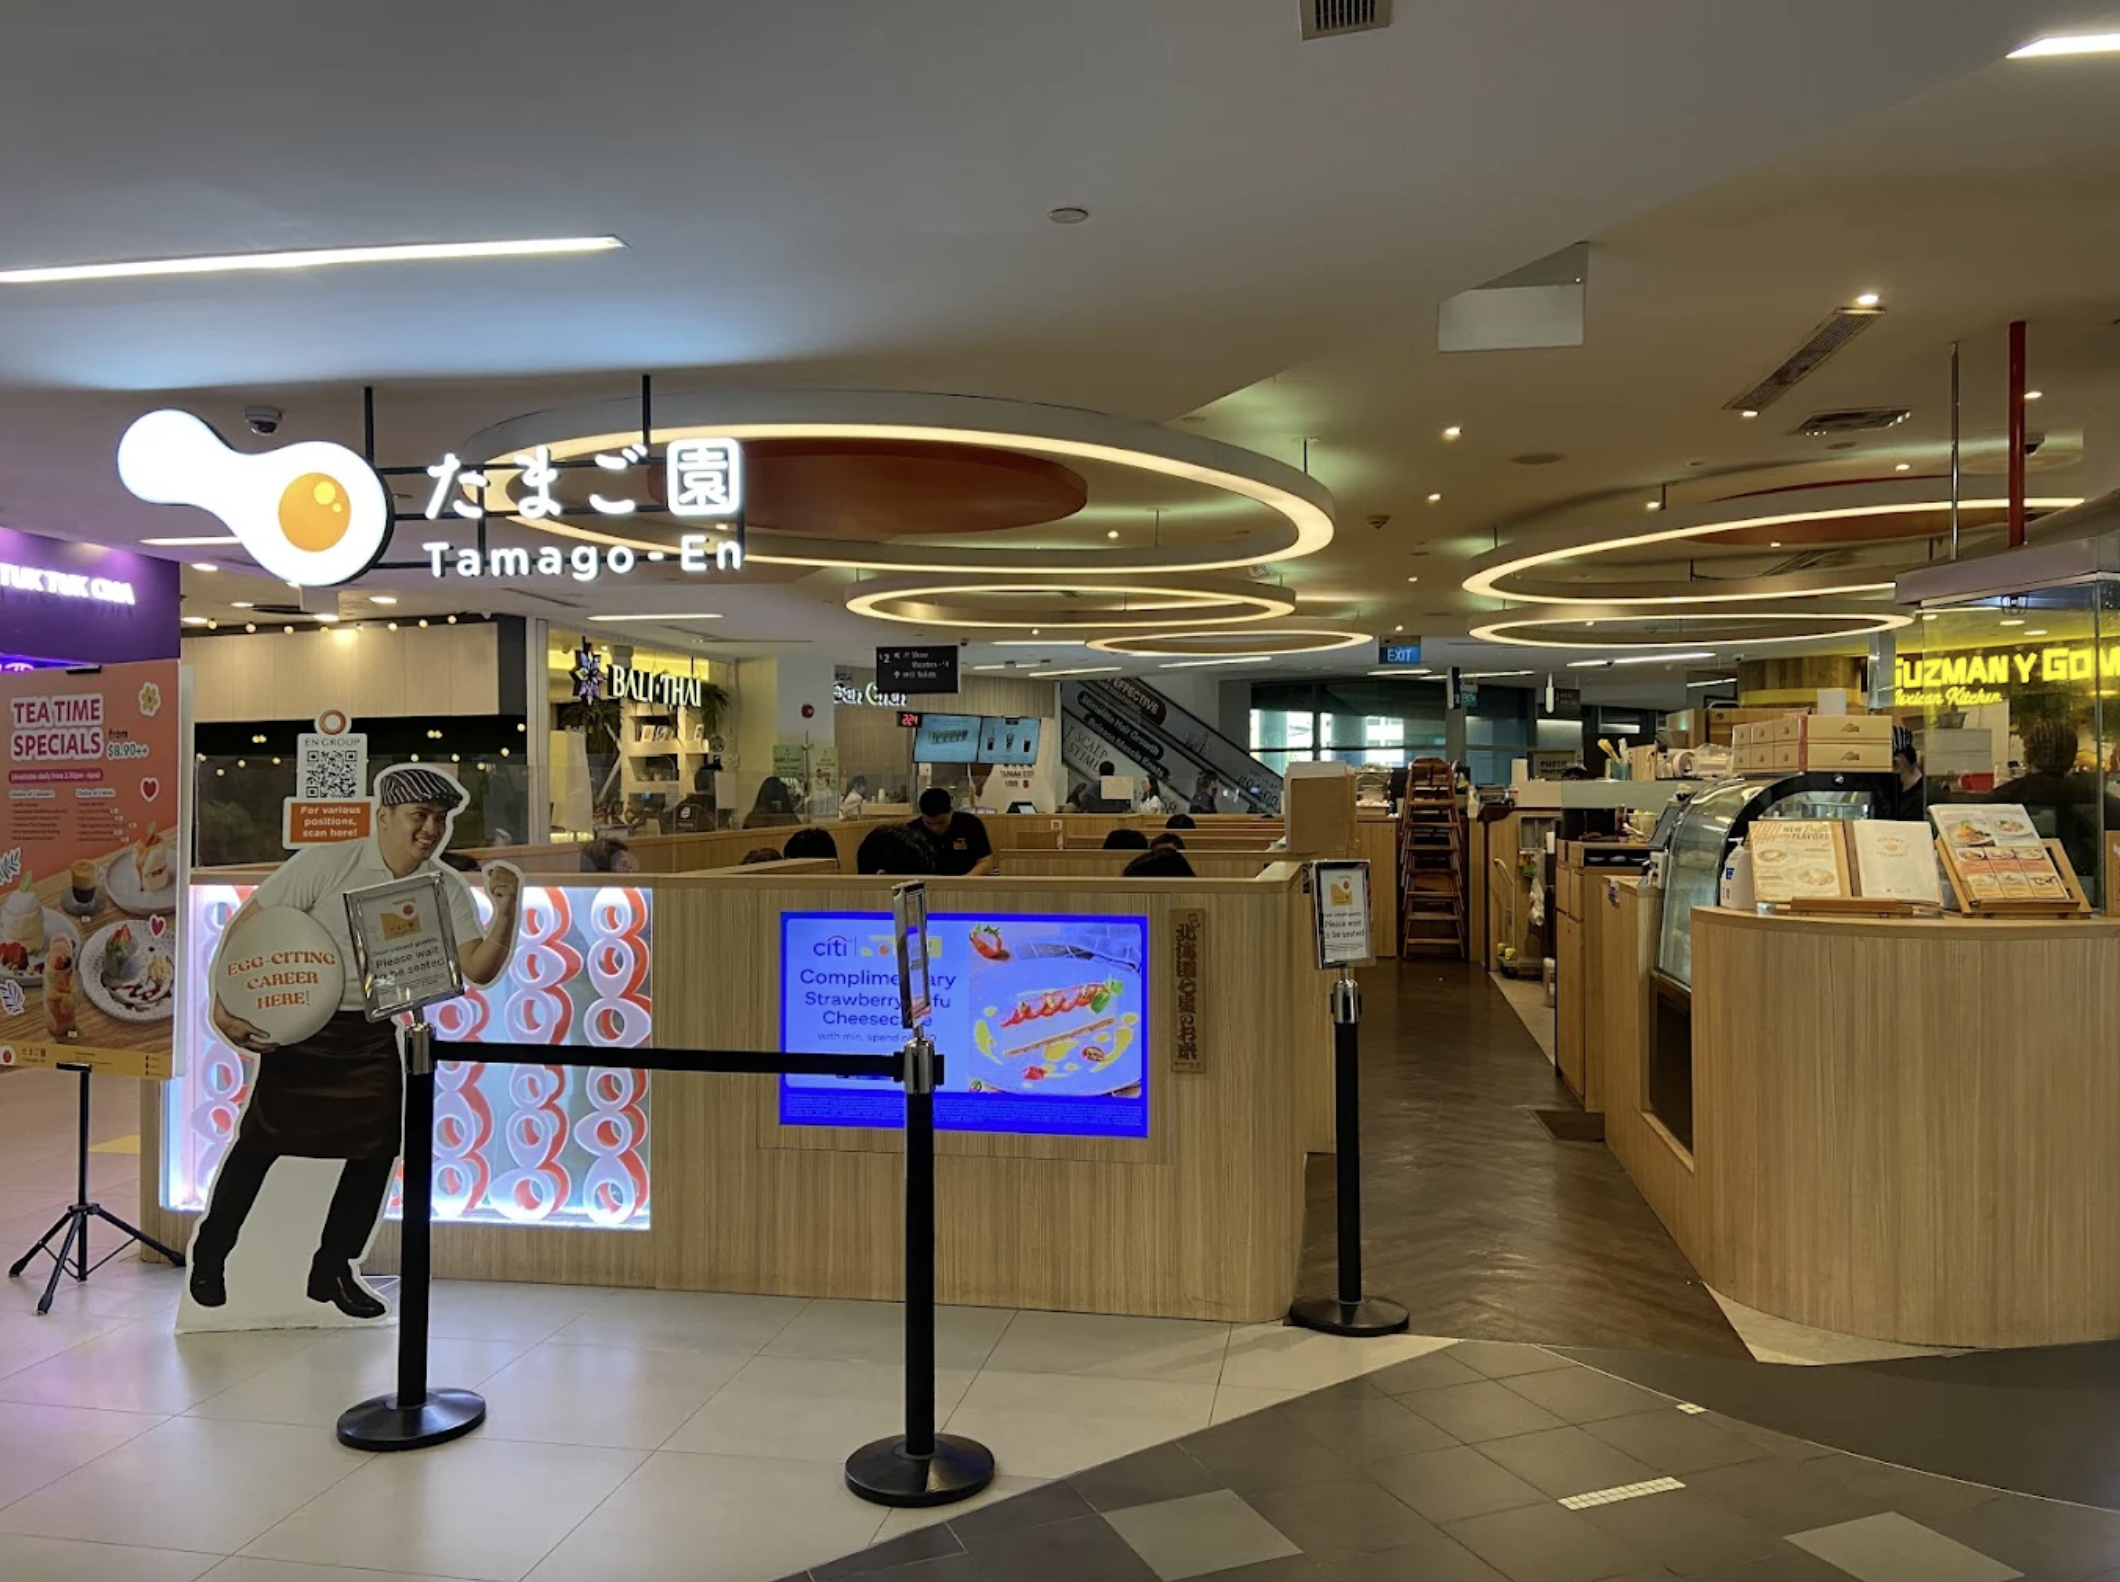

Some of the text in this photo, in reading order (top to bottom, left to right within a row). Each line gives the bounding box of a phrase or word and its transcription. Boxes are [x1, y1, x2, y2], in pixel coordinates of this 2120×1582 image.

[425, 437, 743, 519] たまご園
[1387, 648, 1412, 662] EXIT
[2014, 652, 2037, 683] Y
[14, 699, 101, 724] TEA TIME
[14, 732, 101, 757] SPECIALS
[108, 729, 128, 739] from
[305, 738, 360, 747] EN GROUP
[301, 806, 361, 814] For various
[302, 829, 327, 838] scan
[813, 936, 848, 957] citi
[227, 950, 336, 977] EGG-CITING
[375, 946, 439, 969] Please wait
[407, 956, 446, 974] seated
[246, 971, 319, 990] CAREER
[800, 969, 957, 990] Complimeary
[256, 989, 311, 1010] HERE!
[822, 1010, 933, 1027] Cheesece
